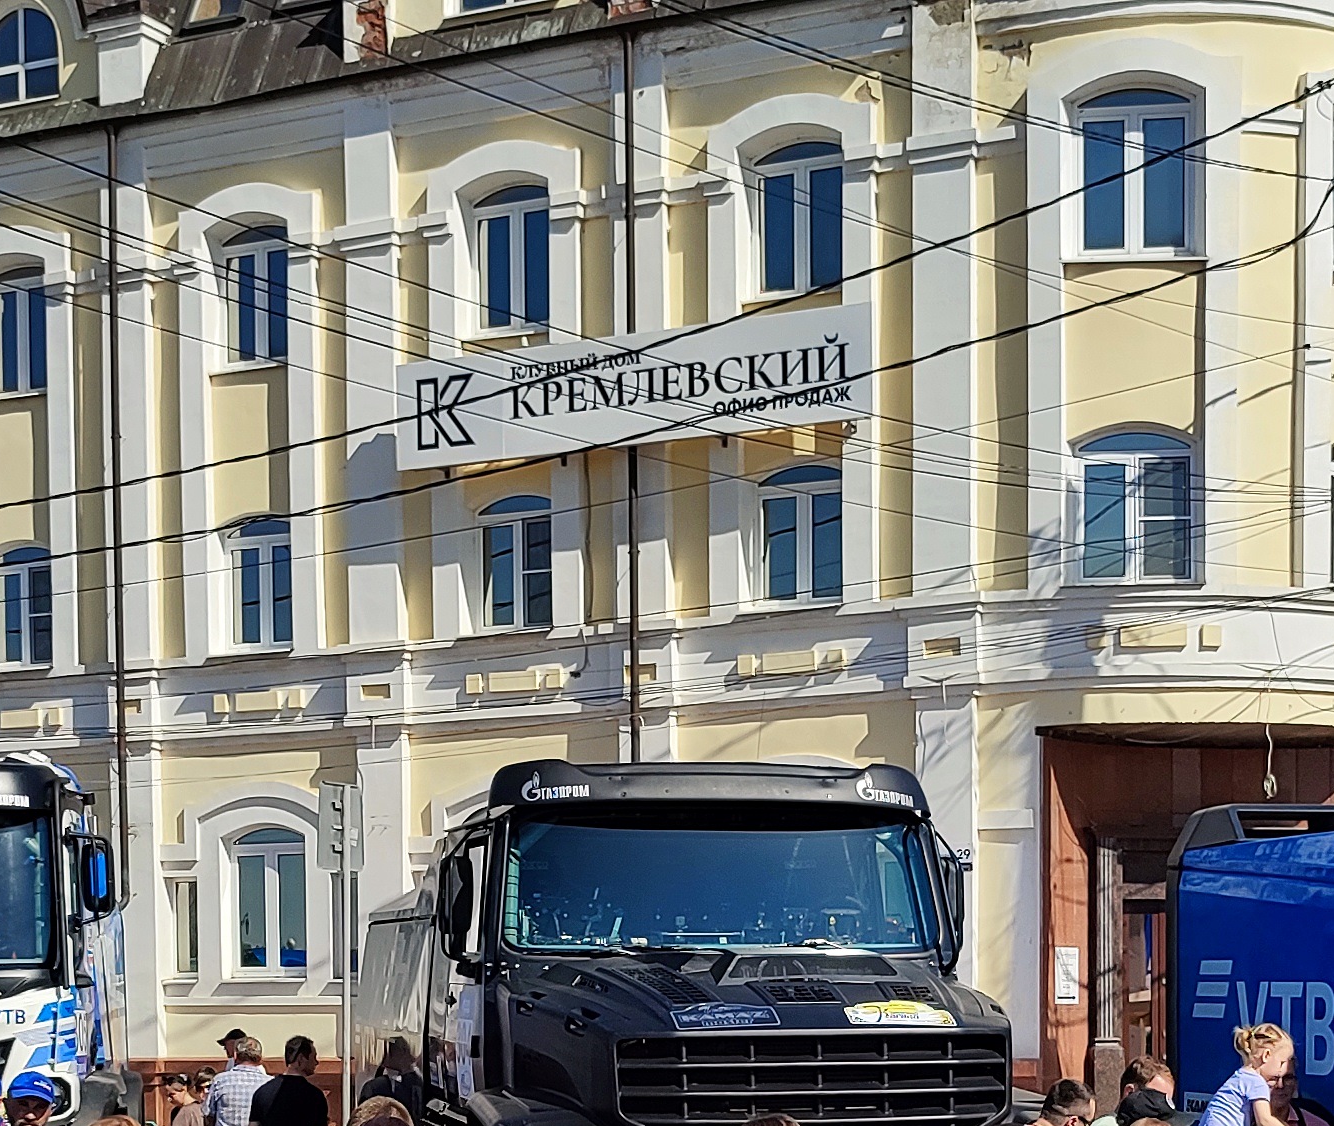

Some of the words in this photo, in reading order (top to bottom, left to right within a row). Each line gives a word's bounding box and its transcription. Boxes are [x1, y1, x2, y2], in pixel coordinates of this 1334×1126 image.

[602, 352, 642, 372] ДОМ
[508, 333, 851, 420] КРЕМЛЕВСКИЙ
[772, 385, 853, 408] ПРОДАЖ
[541, 784, 590, 801] ГАЗПРОМ
[873, 788, 914, 808] ГАЗПРОМ
